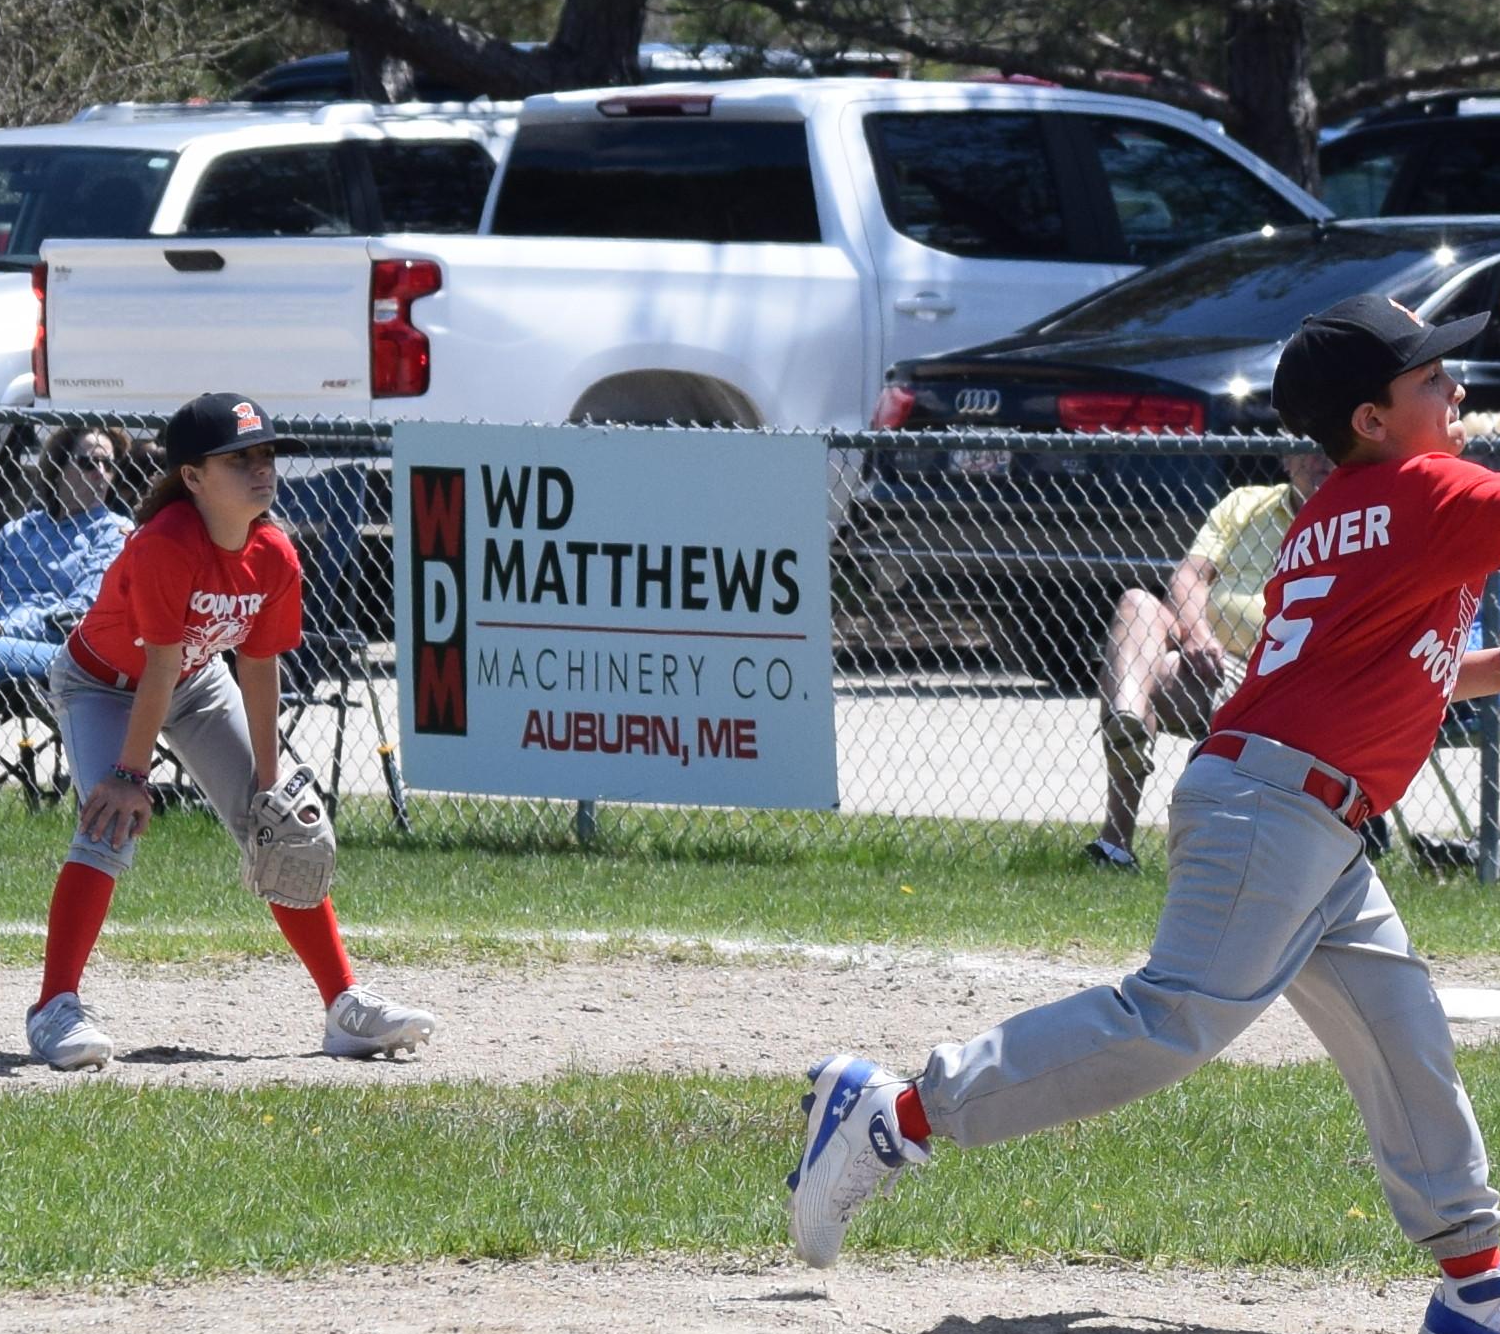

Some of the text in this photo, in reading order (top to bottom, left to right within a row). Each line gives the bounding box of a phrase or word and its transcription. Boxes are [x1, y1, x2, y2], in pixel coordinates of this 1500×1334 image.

[53, 378, 125, 389] SILVERADO
[480, 464, 575, 531] WD
[1275, 504, 1392, 574] ARVER
[481, 537, 801, 616] MATTHEWS
[1257, 575, 1336, 677] 5
[477, 647, 809, 702] MACHINERY CO.
[520, 709, 759, 767] AUBURN, ME
